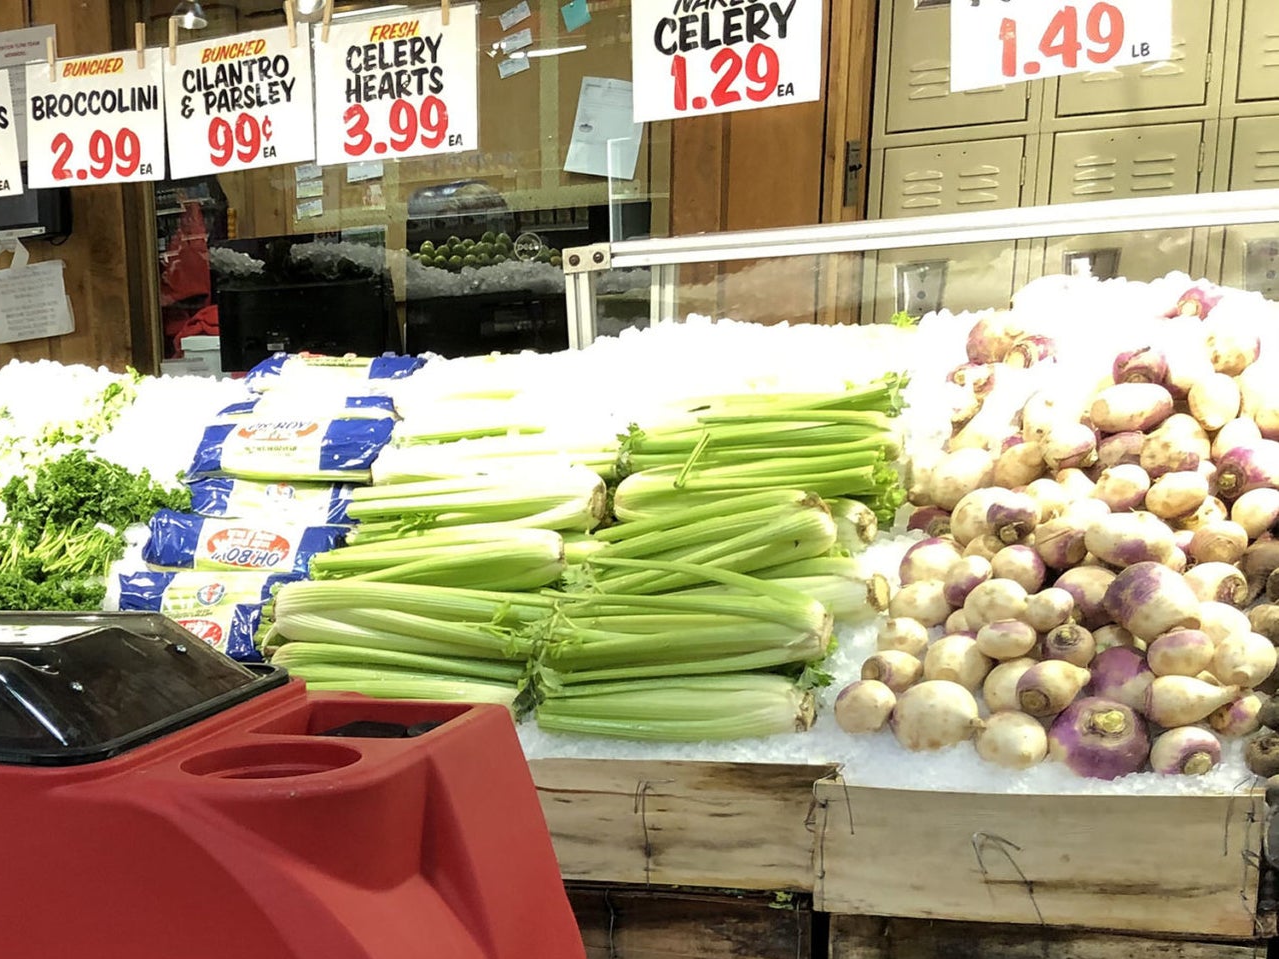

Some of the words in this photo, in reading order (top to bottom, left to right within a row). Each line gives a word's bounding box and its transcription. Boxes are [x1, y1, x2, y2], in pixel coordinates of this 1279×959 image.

[370, 20, 419, 42] FRESH
[654, 0, 796, 56] CELERY
[999, 2, 1124, 77] 1.49
[1131, 42, 1150, 58] LB
[63, 57, 124, 77] BUNCHED
[201, 39, 266, 64] BUNCHED
[345, 32, 443, 74] CELERY
[182, 54, 289, 94] CILANTRO
[345, 66, 443, 103] HEARTS
[671, 43, 779, 111] 1.29
[777, 82, 794, 97] EA
[31, 85, 158, 121] BROCCOLINI
[181, 95, 195, 119] &
[203, 76, 296, 115] PARSLEY
[343, 95, 449, 156] 3.99
[448, 134, 463, 147] EA
[51, 127, 141, 181] 2.99
[140, 163, 153, 175] EA
[263, 146, 277, 158] EA
